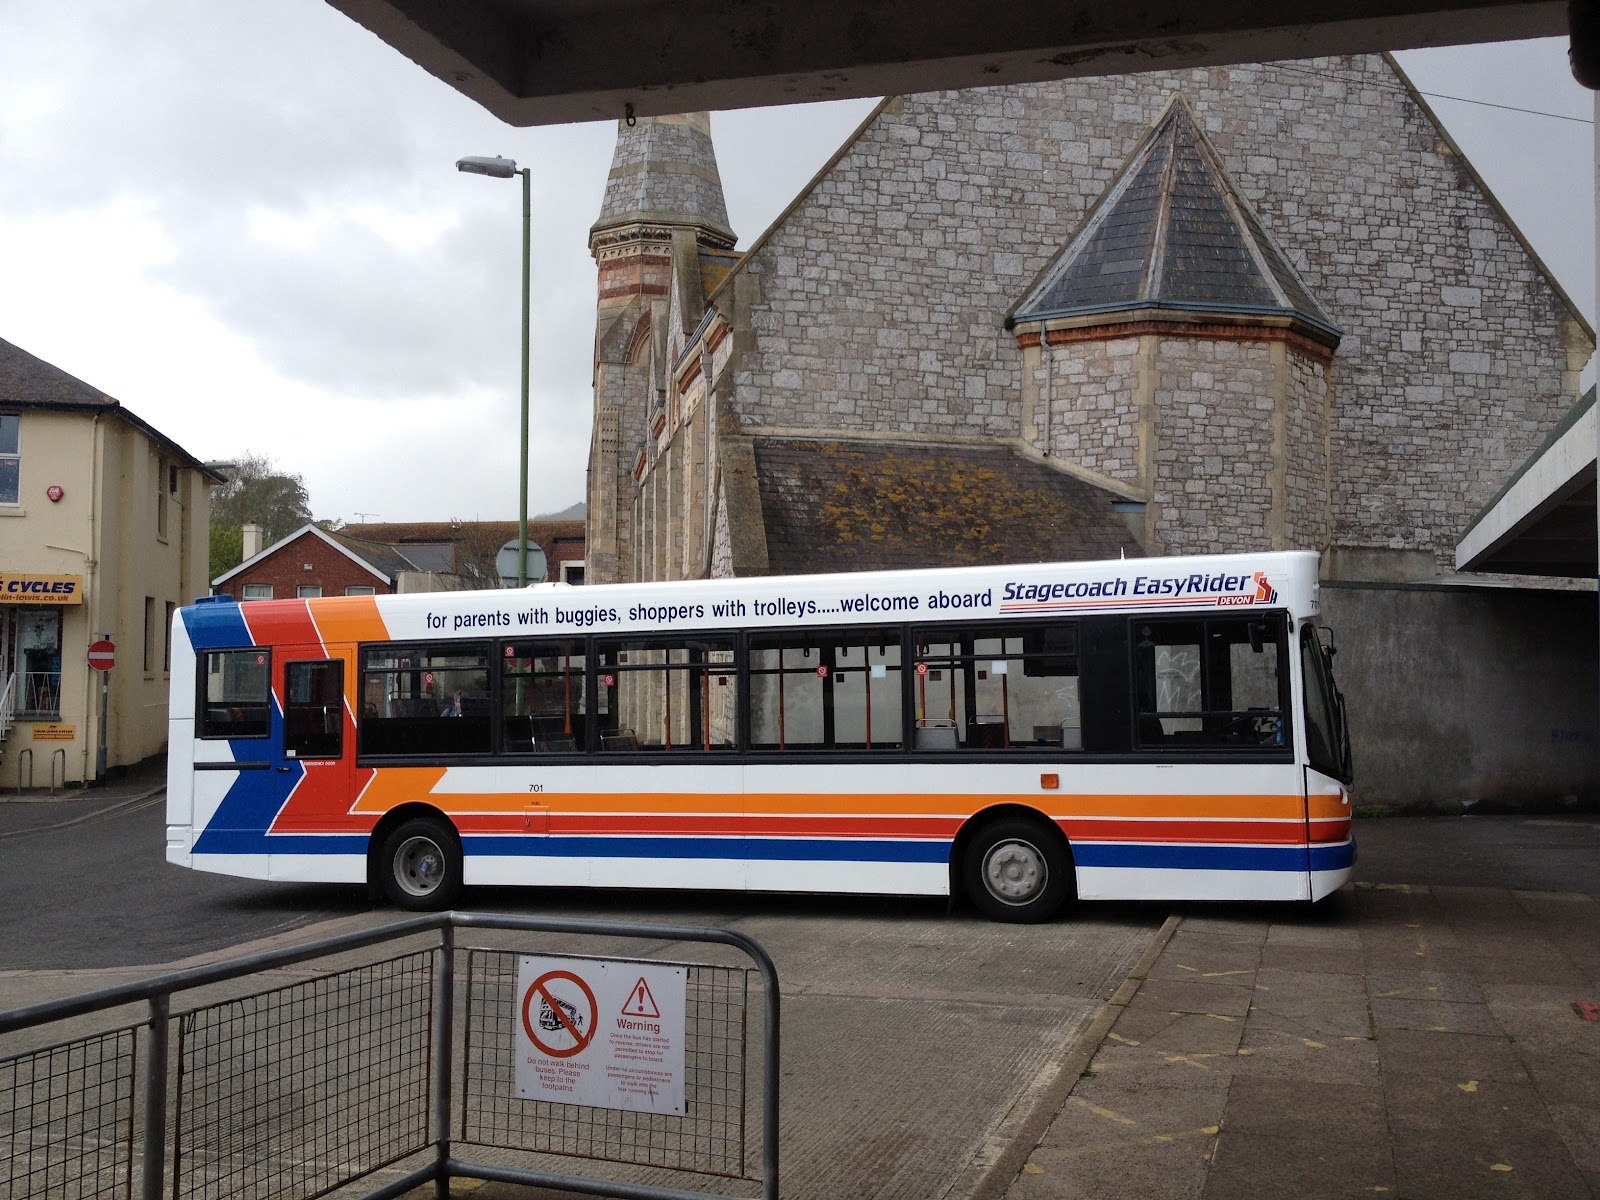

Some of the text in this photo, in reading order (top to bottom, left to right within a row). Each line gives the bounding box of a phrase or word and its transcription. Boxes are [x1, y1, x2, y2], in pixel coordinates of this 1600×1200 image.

[8, 581, 75, 593] CYCLES
[1003, 573, 1251, 602] Stagecoach EasyRider
[1219, 596, 1251, 605] DEVON
[427, 613, 447, 628] for
[454, 610, 510, 630] parents
[517, 608, 549, 625] with
[556, 605, 621, 627] buggies,
[629, 604, 704, 623] shoppers
[712, 599, 746, 617] with
[928, 589, 992, 609] aboard
[529, 784, 543, 792] 701
[617, 1018, 660, 1034] Warning
[566, 1061, 590, 1070] behind
[536, 1066, 580, 1077] buses. Please
[629, 1068, 663, 1076] circumstances
[539, 1074, 556, 1083] keep
[542, 1082, 573, 1092] footpaths
